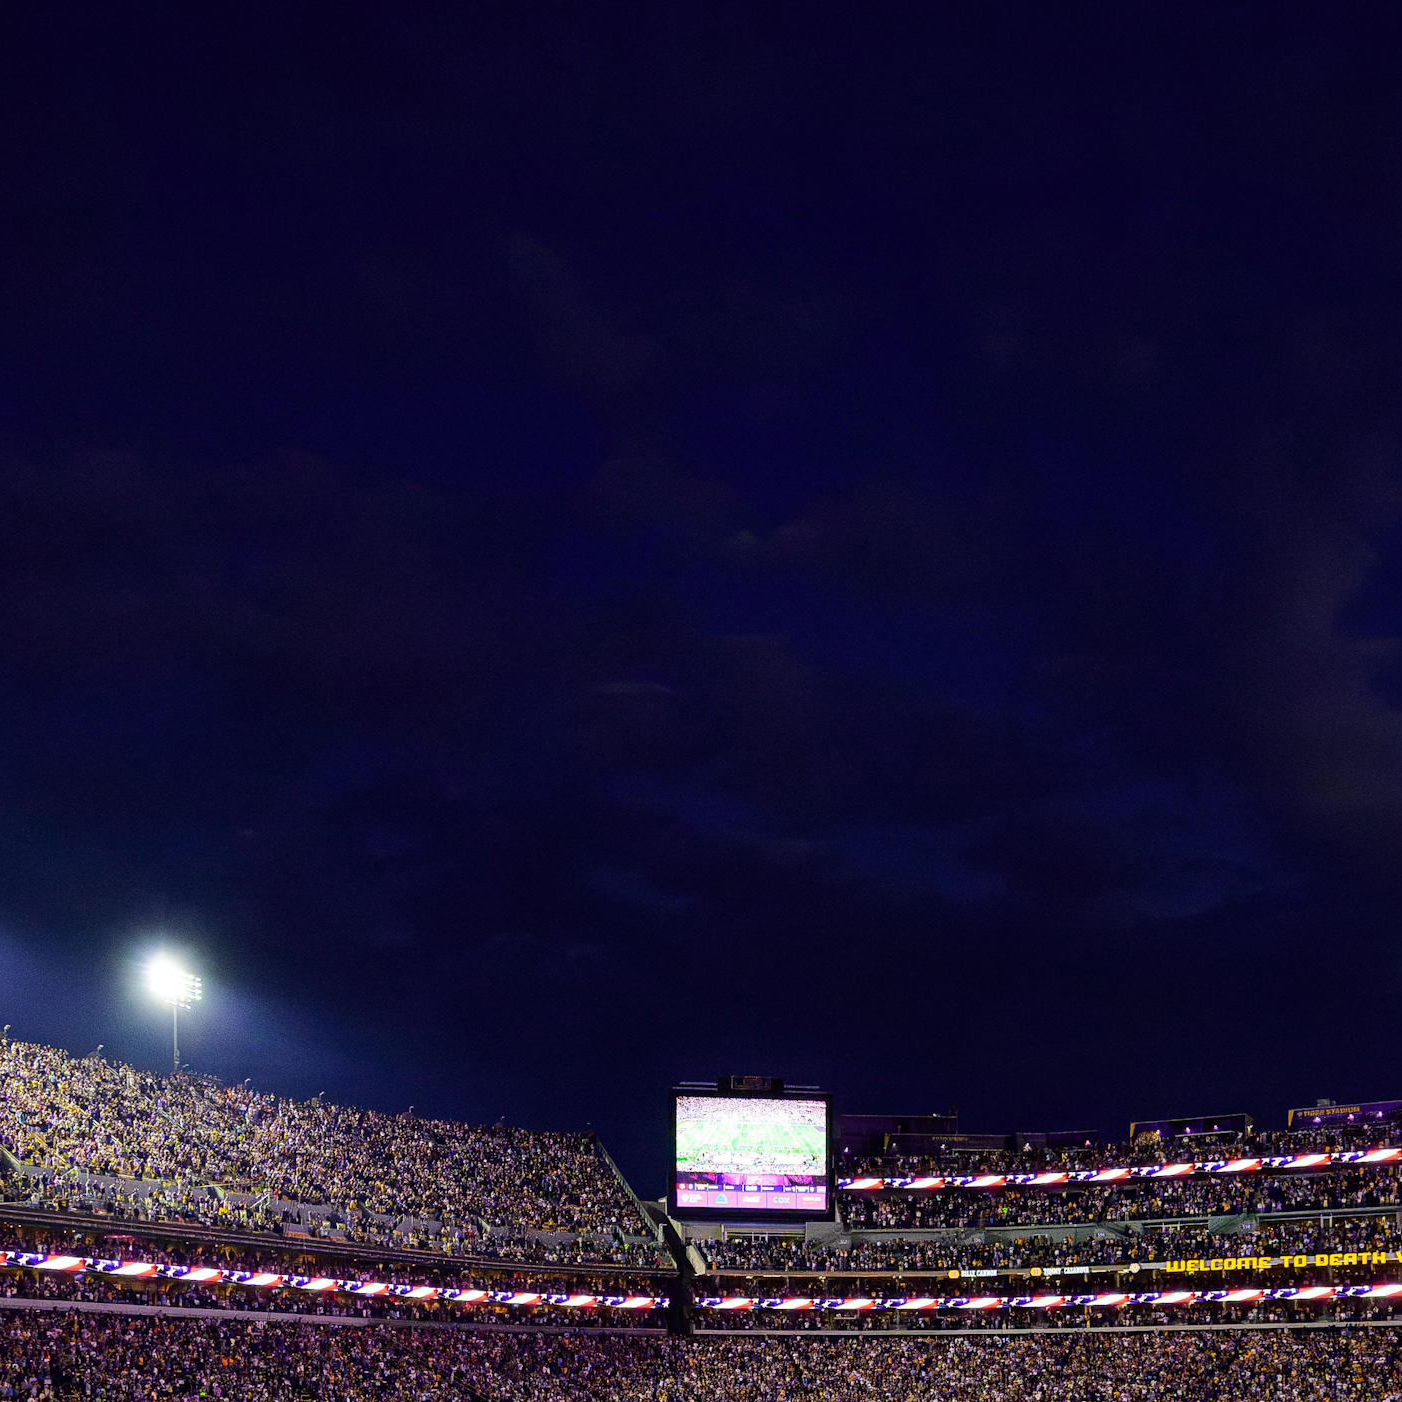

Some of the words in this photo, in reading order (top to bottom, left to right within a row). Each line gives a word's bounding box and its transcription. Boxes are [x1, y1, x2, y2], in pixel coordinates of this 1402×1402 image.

[1303, 1109, 1325, 1117] TIGER
[1326, 1106, 1360, 1115] STADIUM
[1165, 1257, 1273, 1273] WELCOME
[1280, 1254, 1308, 1268] TO
[1315, 1251, 1387, 1267] DEATH
[961, 1270, 976, 1278] BILLY
[976, 1269, 998, 1277] CANNON
